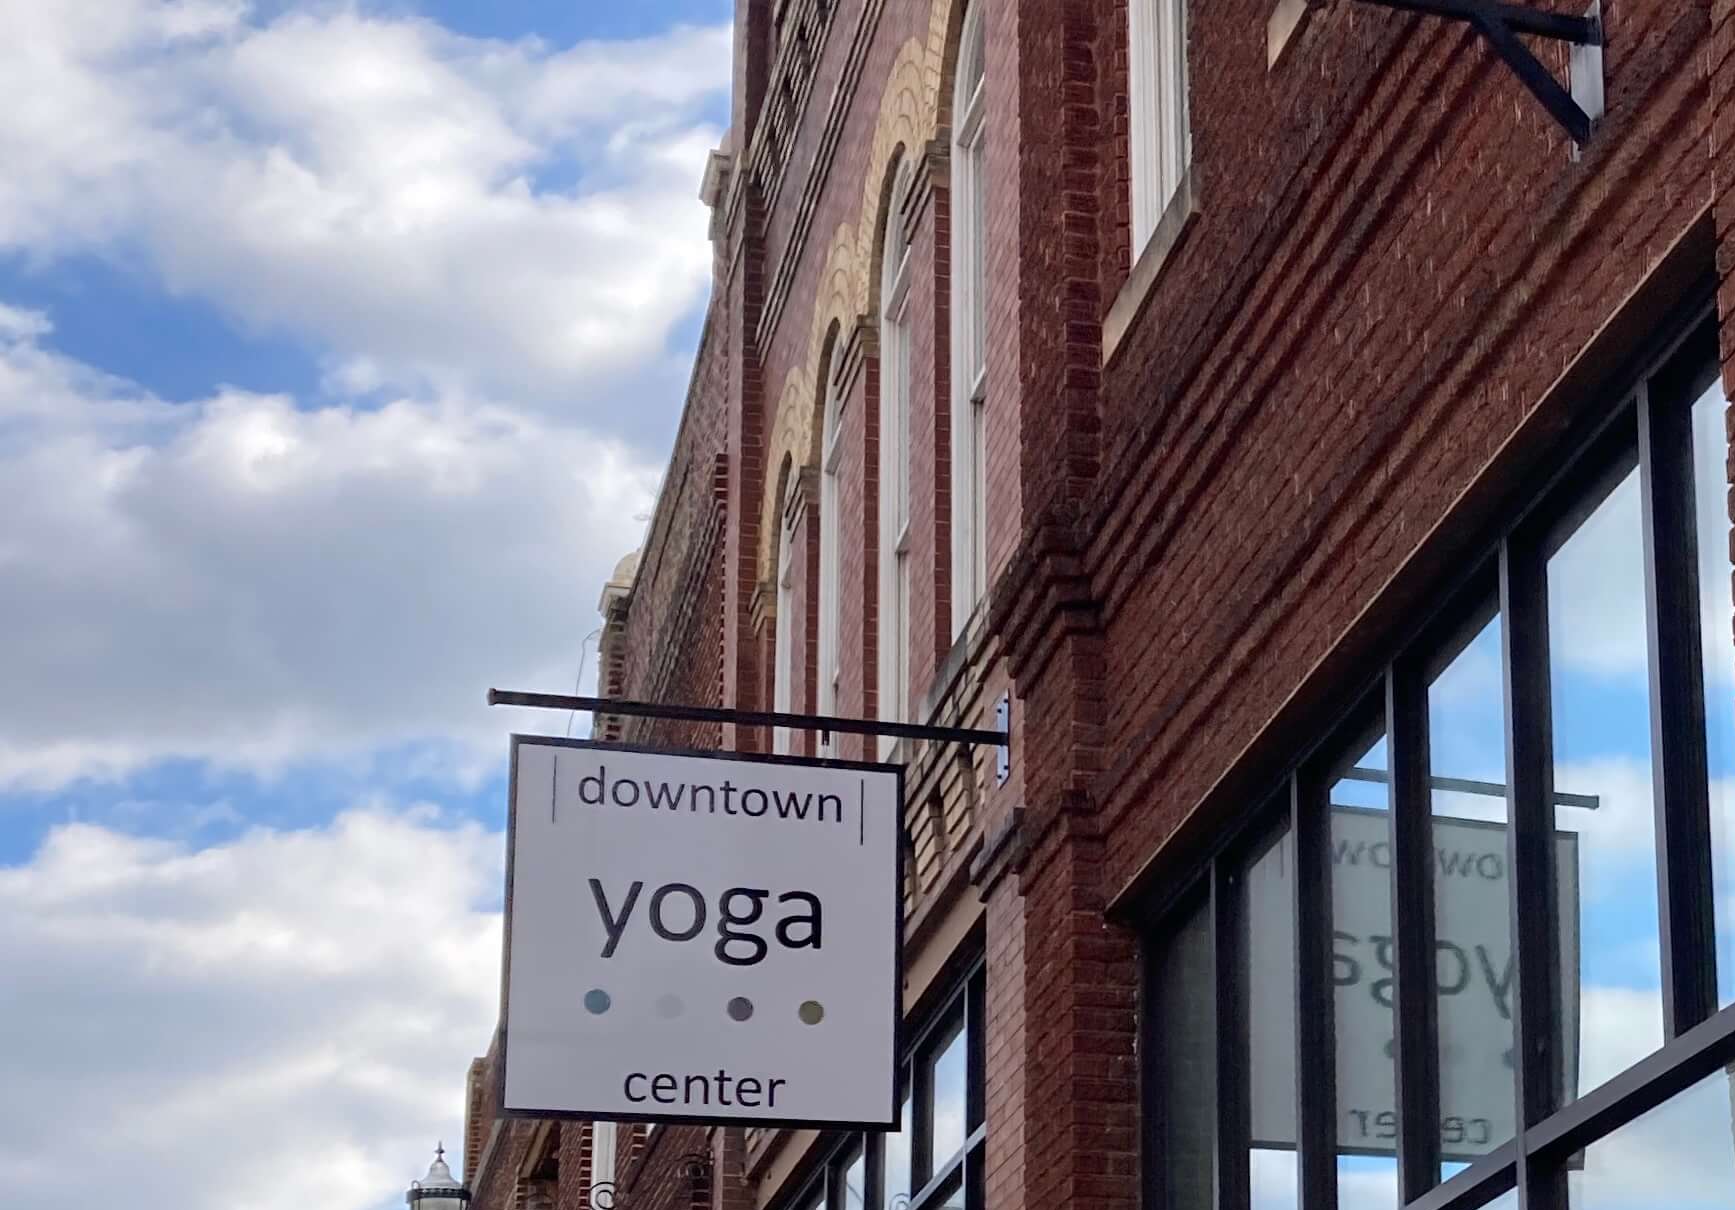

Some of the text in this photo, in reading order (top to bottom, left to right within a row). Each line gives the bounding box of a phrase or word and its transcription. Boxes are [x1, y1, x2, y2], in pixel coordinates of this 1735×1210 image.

[578, 765, 844, 823] downtown
[587, 878, 823, 967] yoga
[623, 1069, 786, 1107] center
